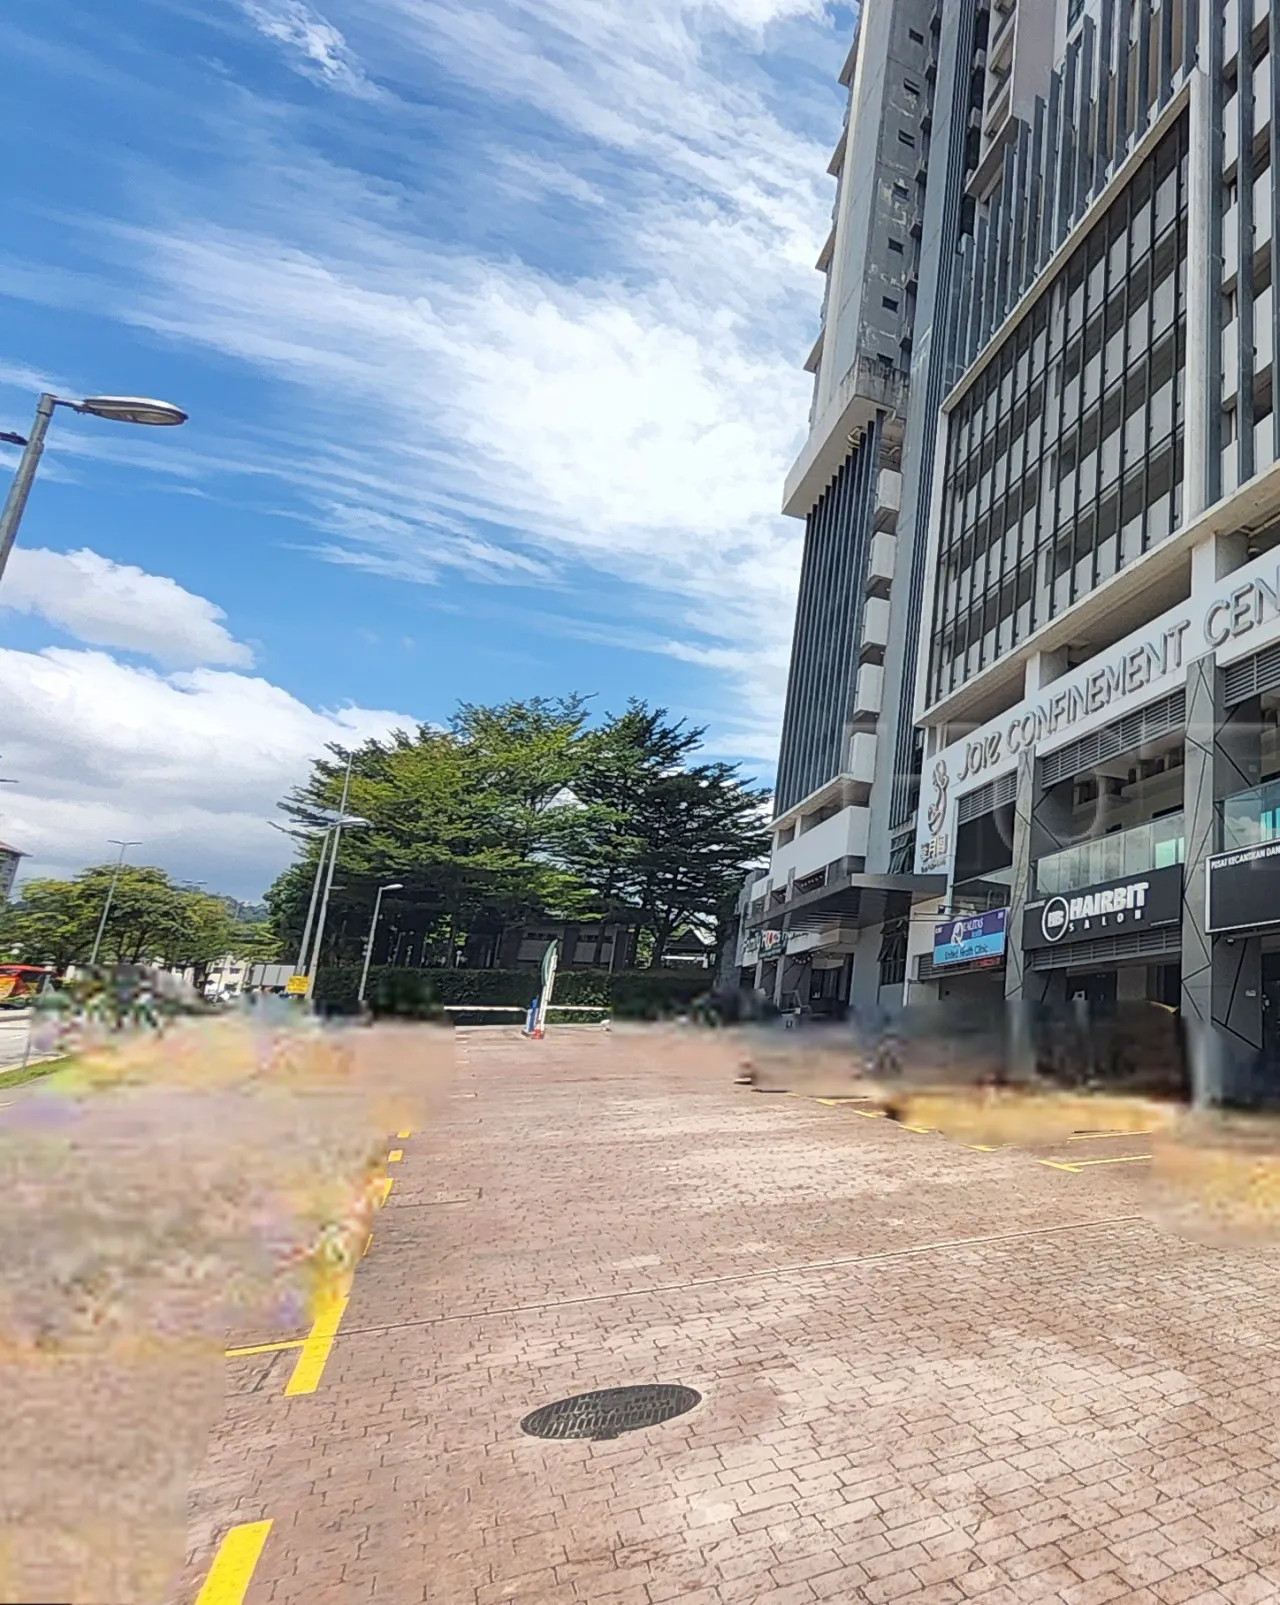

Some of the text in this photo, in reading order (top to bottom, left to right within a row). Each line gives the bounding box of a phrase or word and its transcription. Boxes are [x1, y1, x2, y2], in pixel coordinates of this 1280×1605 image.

[1007, 618, 1191, 753] CONFINEMENT
[1266, 846, 1280, 857] DAN
[1069, 882, 1149, 920] HAIRBIT
